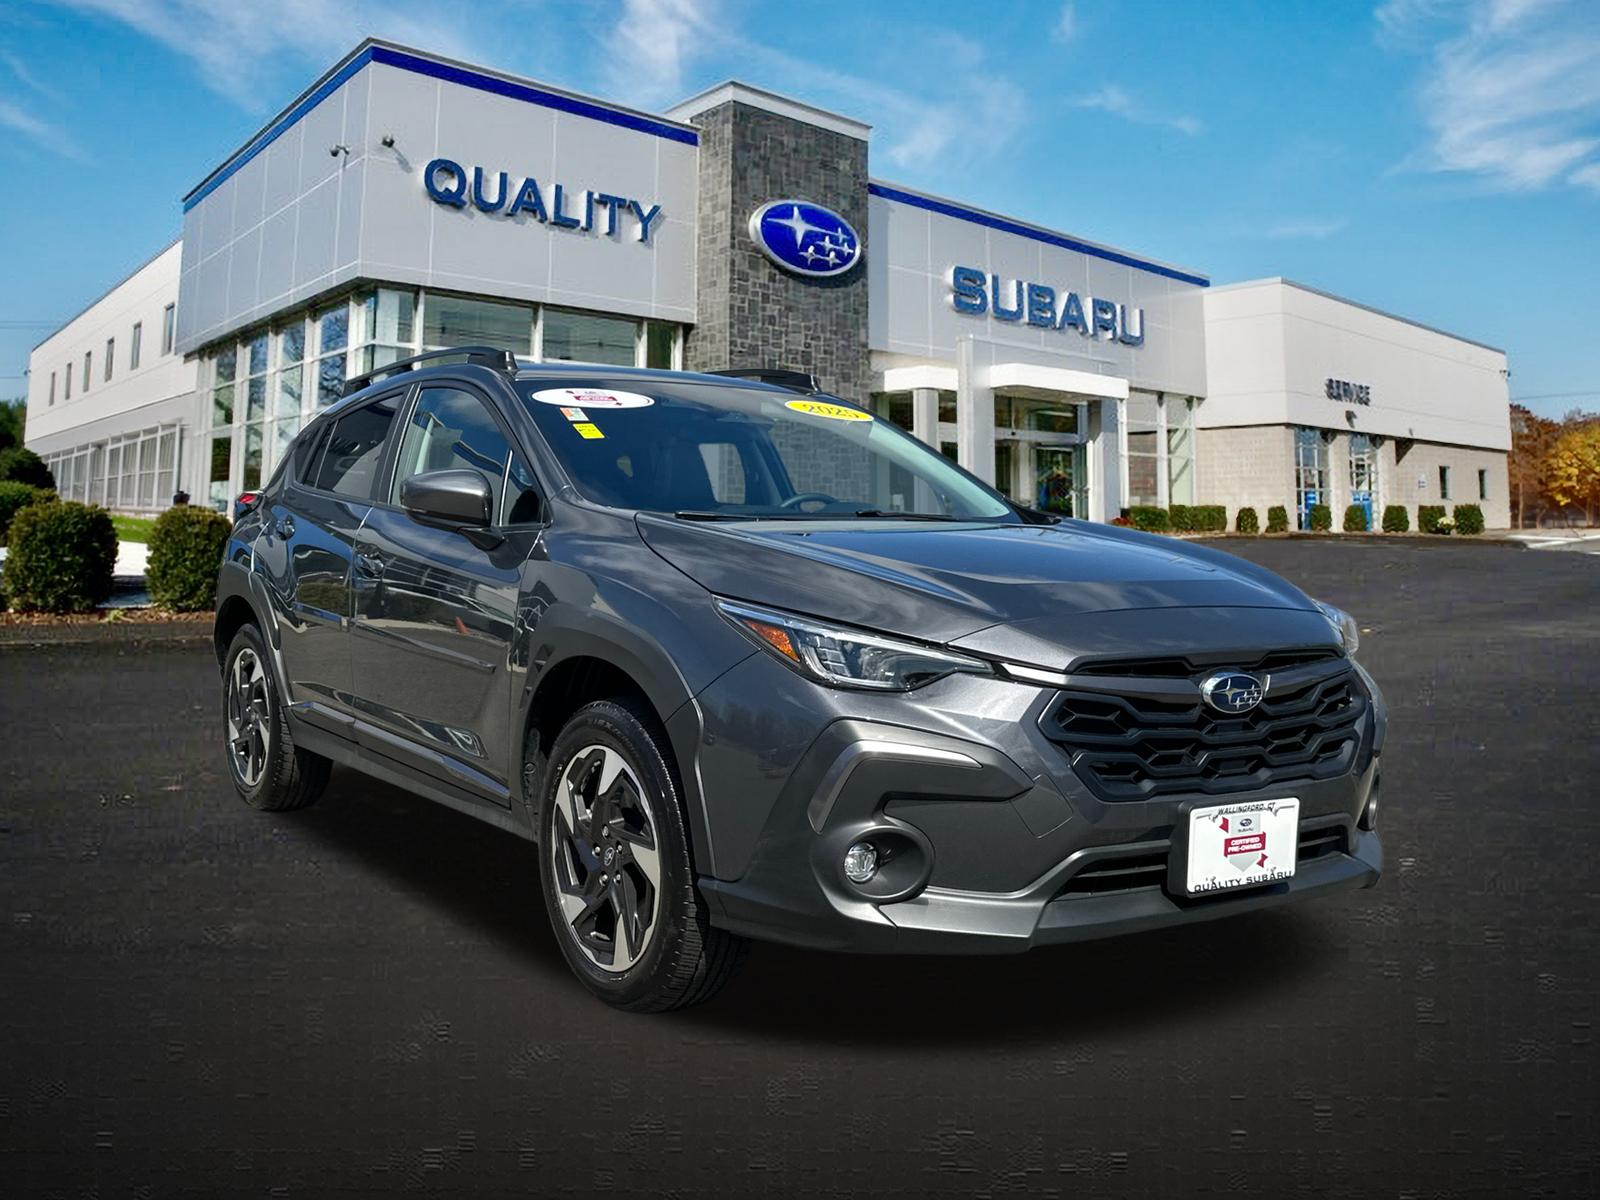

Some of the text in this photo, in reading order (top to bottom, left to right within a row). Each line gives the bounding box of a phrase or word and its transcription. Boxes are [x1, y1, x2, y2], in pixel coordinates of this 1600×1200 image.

[424, 158, 661, 243] QUALITY
[950, 265, 1145, 346] SUBARU
[1325, 378, 1371, 406] SERVICE
[1228, 843, 1262, 853] PRE-OWNED
[1231, 837, 1260, 846] CERTIFIED
[1194, 870, 1292, 892] QUALITY SUBARU
